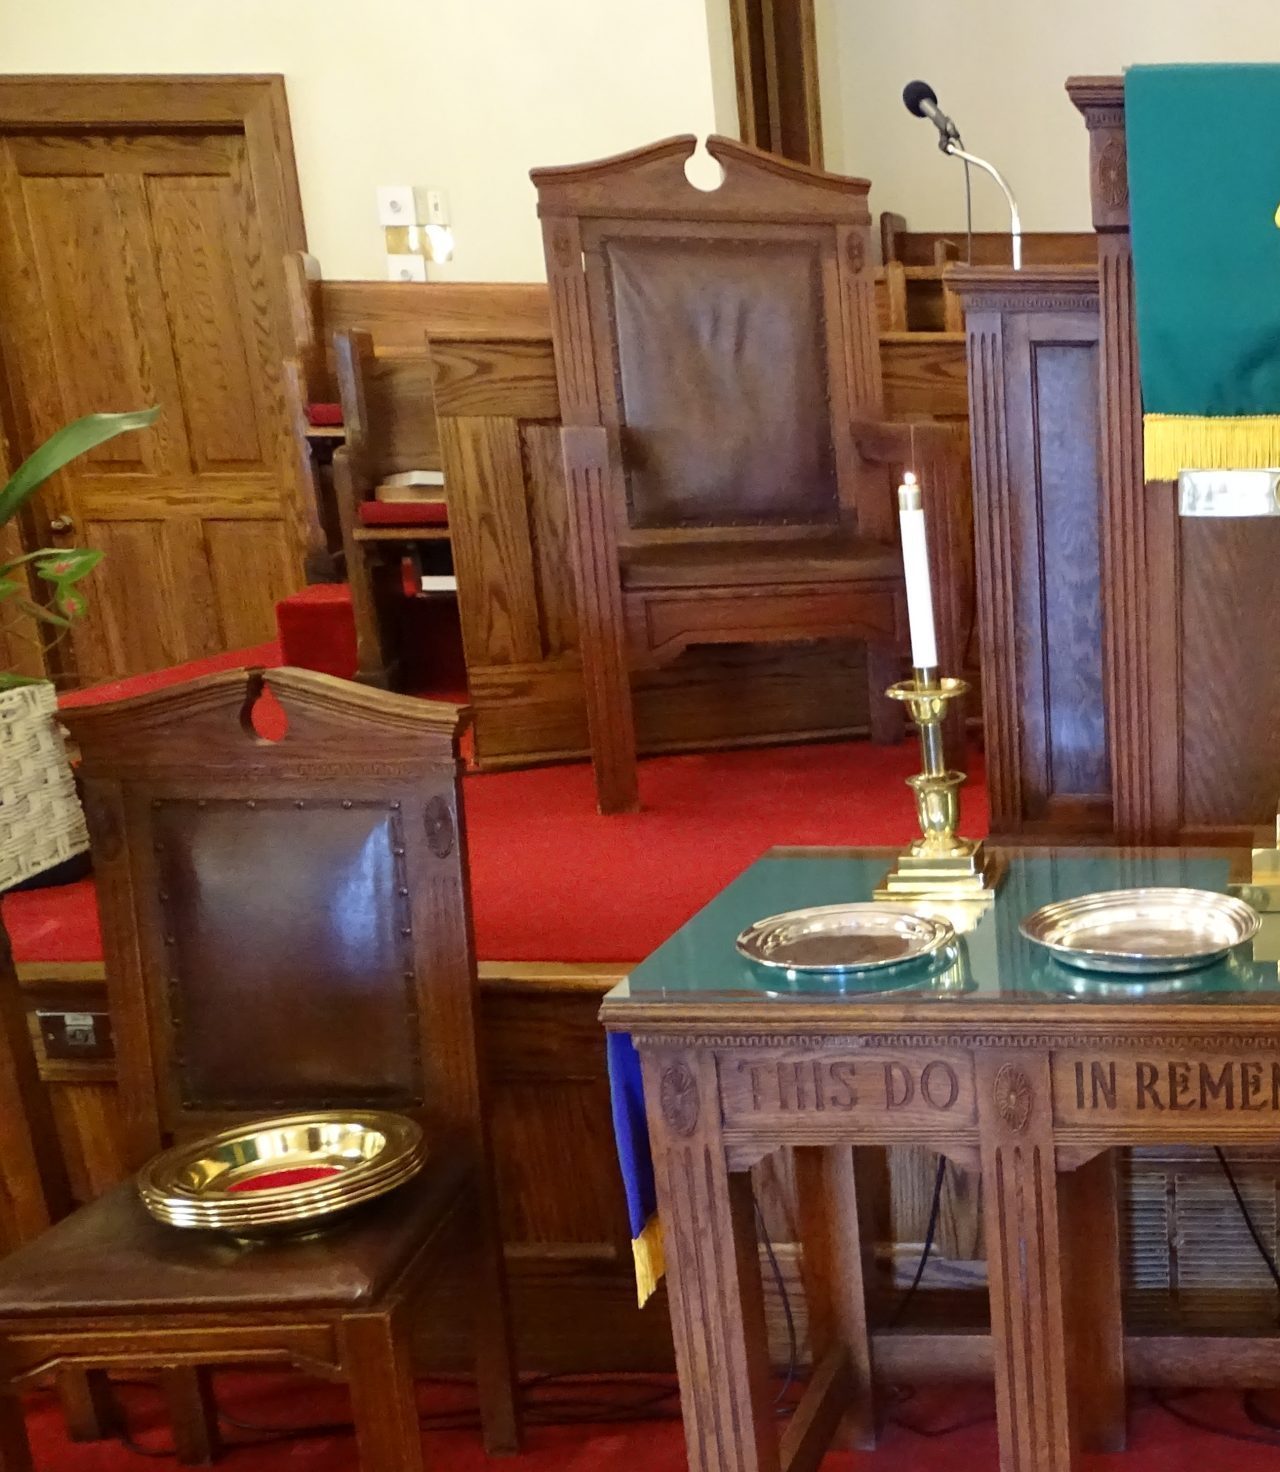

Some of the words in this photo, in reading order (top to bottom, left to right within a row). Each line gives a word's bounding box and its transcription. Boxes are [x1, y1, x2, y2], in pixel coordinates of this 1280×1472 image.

[737, 1059, 858, 1112] THIS
[884, 1060, 959, 1111] DO
[1074, 1061, 1117, 1111] IN
